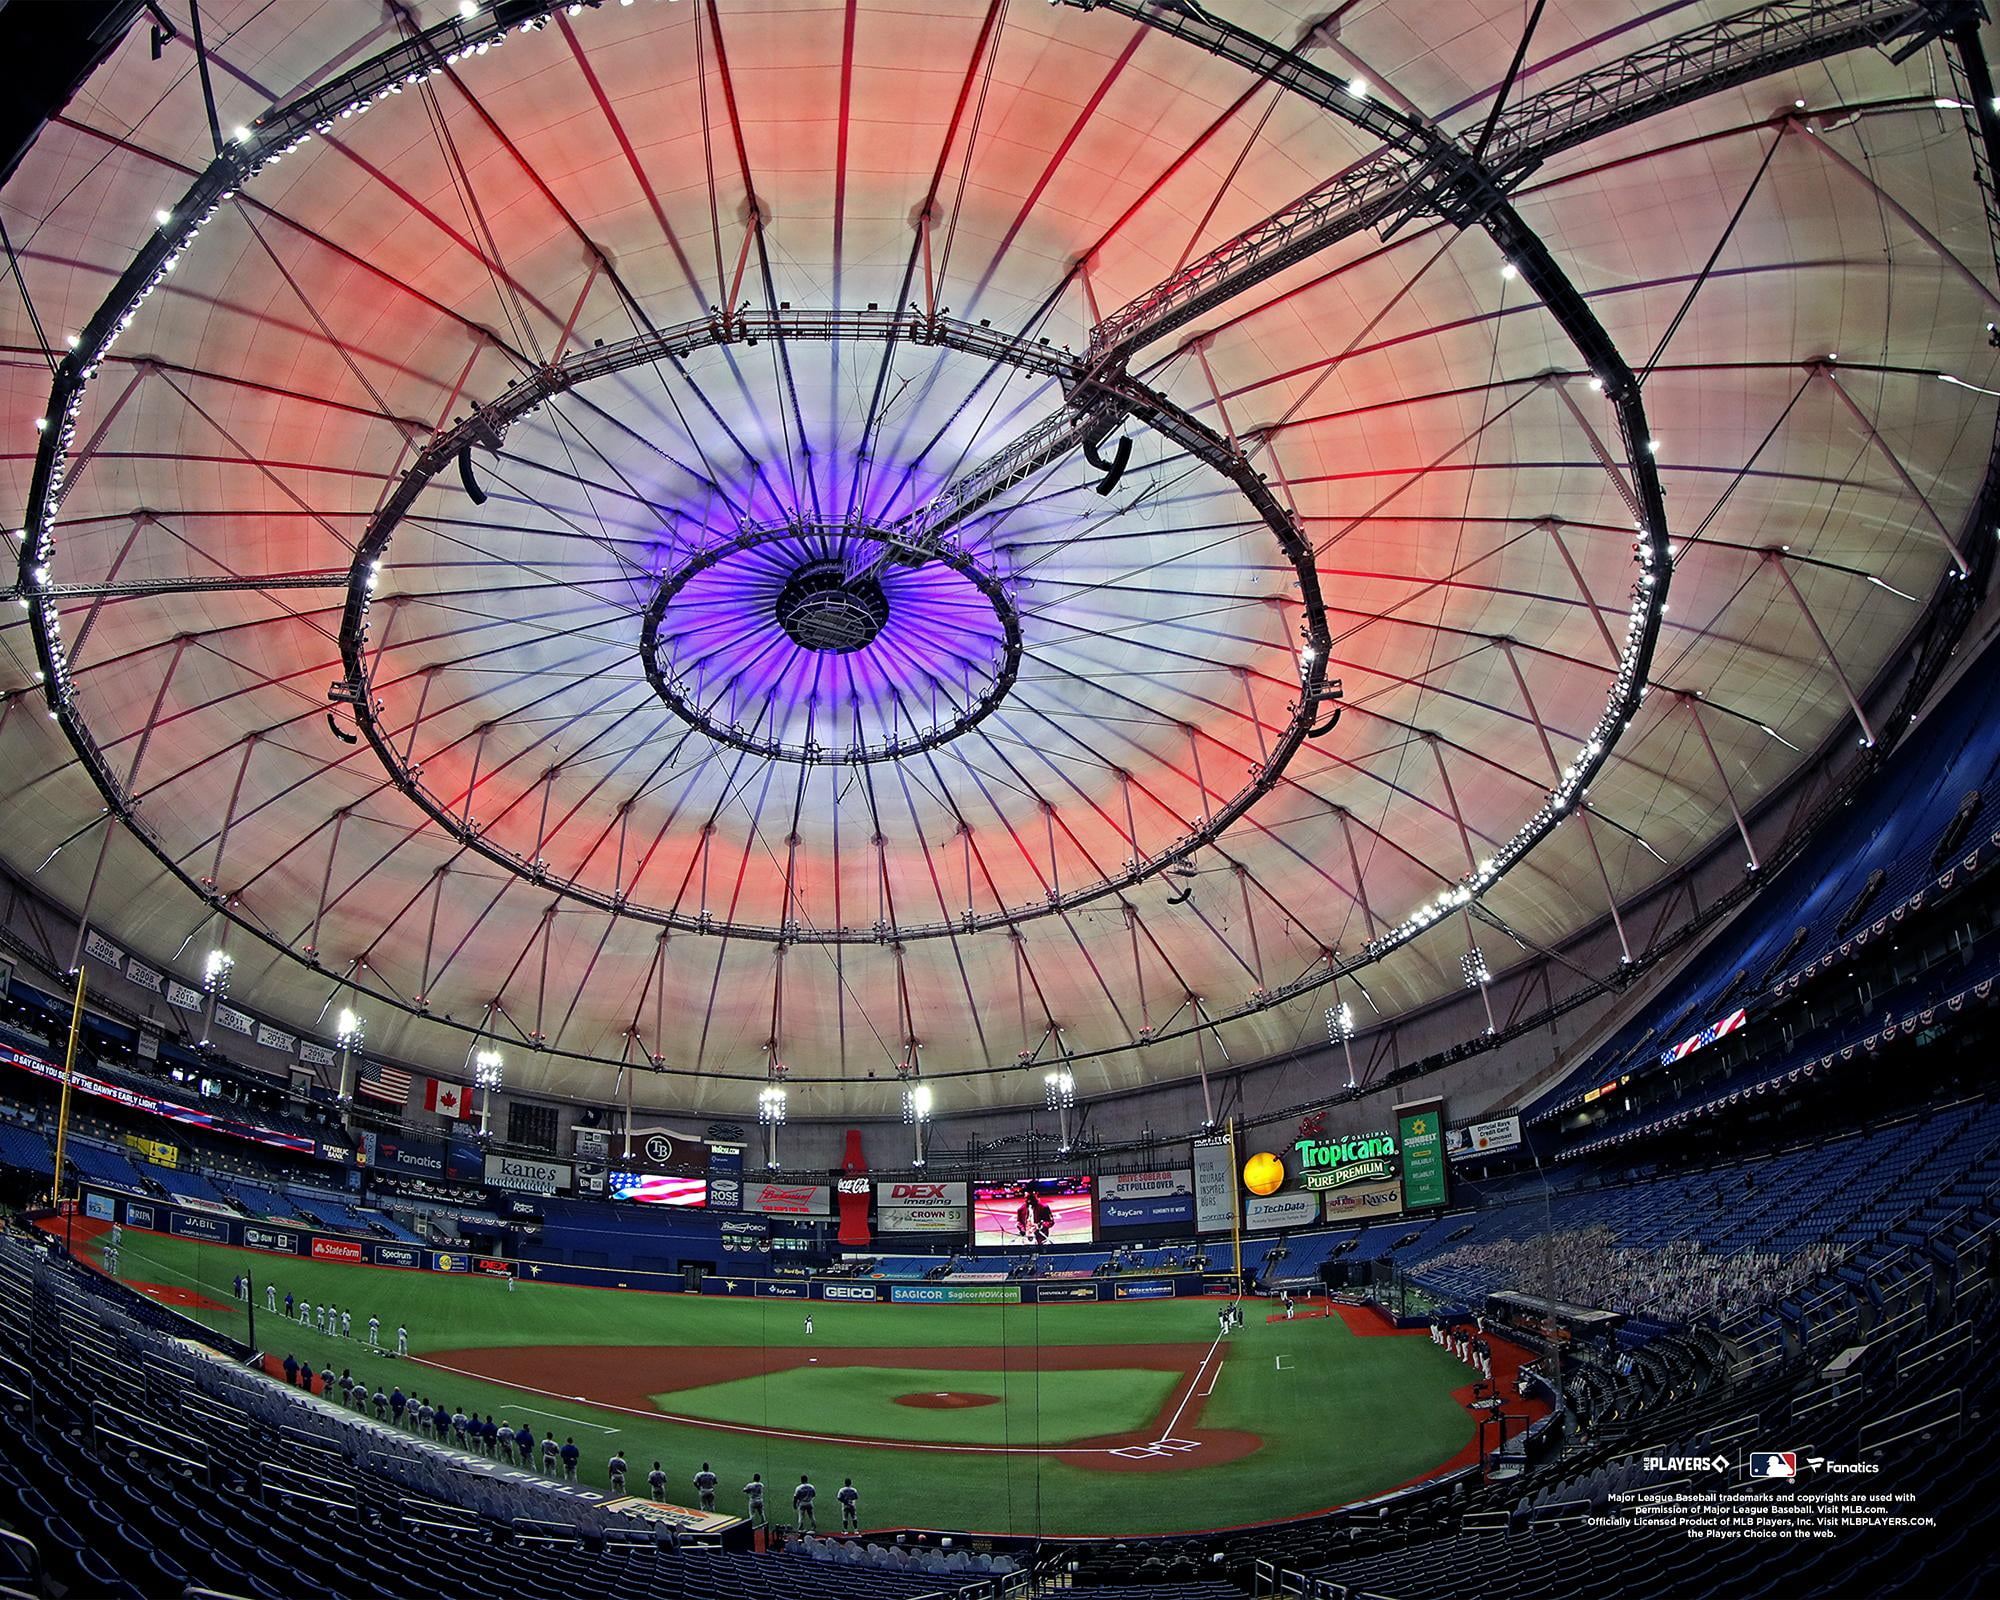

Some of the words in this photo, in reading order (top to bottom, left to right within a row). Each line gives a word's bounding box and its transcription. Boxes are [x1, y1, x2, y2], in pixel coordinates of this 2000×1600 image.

[95, 941, 114, 958] 2008
[87, 945, 117, 967] CHAMPIONS
[135, 968, 154, 983] 2008
[175, 989, 195, 1003] 2010
[224, 1013, 244, 1026] 2011
[267, 1032, 287, 1045] 2013
[18, 1055, 32, 1068] SAY
[31, 1060, 45, 1073] CAN
[45, 1065, 58, 1077] YOU
[71, 1075, 80, 1085] BY
[80, 1078, 93, 1090] THE
[93, 1082, 118, 1099] DAWN'S
[117, 1092, 139, 1105] EARLY
[138, 1097, 158, 1111] LIGHT,
[1352, 1130, 1389, 1141] ORIGINAL
[1480, 1129, 1496, 1137] Credit
[1496, 1126, 1509, 1134] Card
[1488, 1133, 1512, 1142] Suncoast
[1194, 1136, 1222, 1145] MOFFITT
[1404, 1133, 1437, 1146] SUNBELT
[322, 1144, 349, 1156] REPUBLIC
[327, 1150, 344, 1160] BANK
[651, 1140, 668, 1158] TB
[1295, 1137, 1394, 1167] Tropicana
[397, 1150, 442, 1169] Fanatics
[500, 1158, 557, 1181] kanes
[1199, 1162, 1214, 1172] YOUR
[1200, 1173, 1225, 1183] COURAGE
[1307, 1175, 1334, 1187] PURE
[1336, 1162, 1384, 1182] PREMIUM
[891, 1184, 947, 1198] DEX
[1117, 1184, 1129, 1192] GET
[1130, 1182, 1156, 1191] PULLED
[1156, 1180, 1174, 1189] OVER
[1200, 1184, 1225, 1195] INSPIRES
[711, 1190, 739, 1201] ROSE
[1388, 1190, 1398, 1202] 6
[903, 1198, 952, 1206] imaging
[1117, 1209, 1143, 1218] BayCare
[185, 1218, 216, 1230] JABIL
[325, 1244, 359, 1257] StateFarm
[381, 1249, 412, 1260] Spectrum
[480, 1260, 510, 1271] DEX
[825, 1286, 875, 1299] GEICO
[894, 1290, 943, 1299] SAGICOR
[948, 1291, 1018, 1299] SagicorNOW.com
[348, 1418, 497, 1470] TROPICANA
[502, 1471, 604, 1500] FIELD
